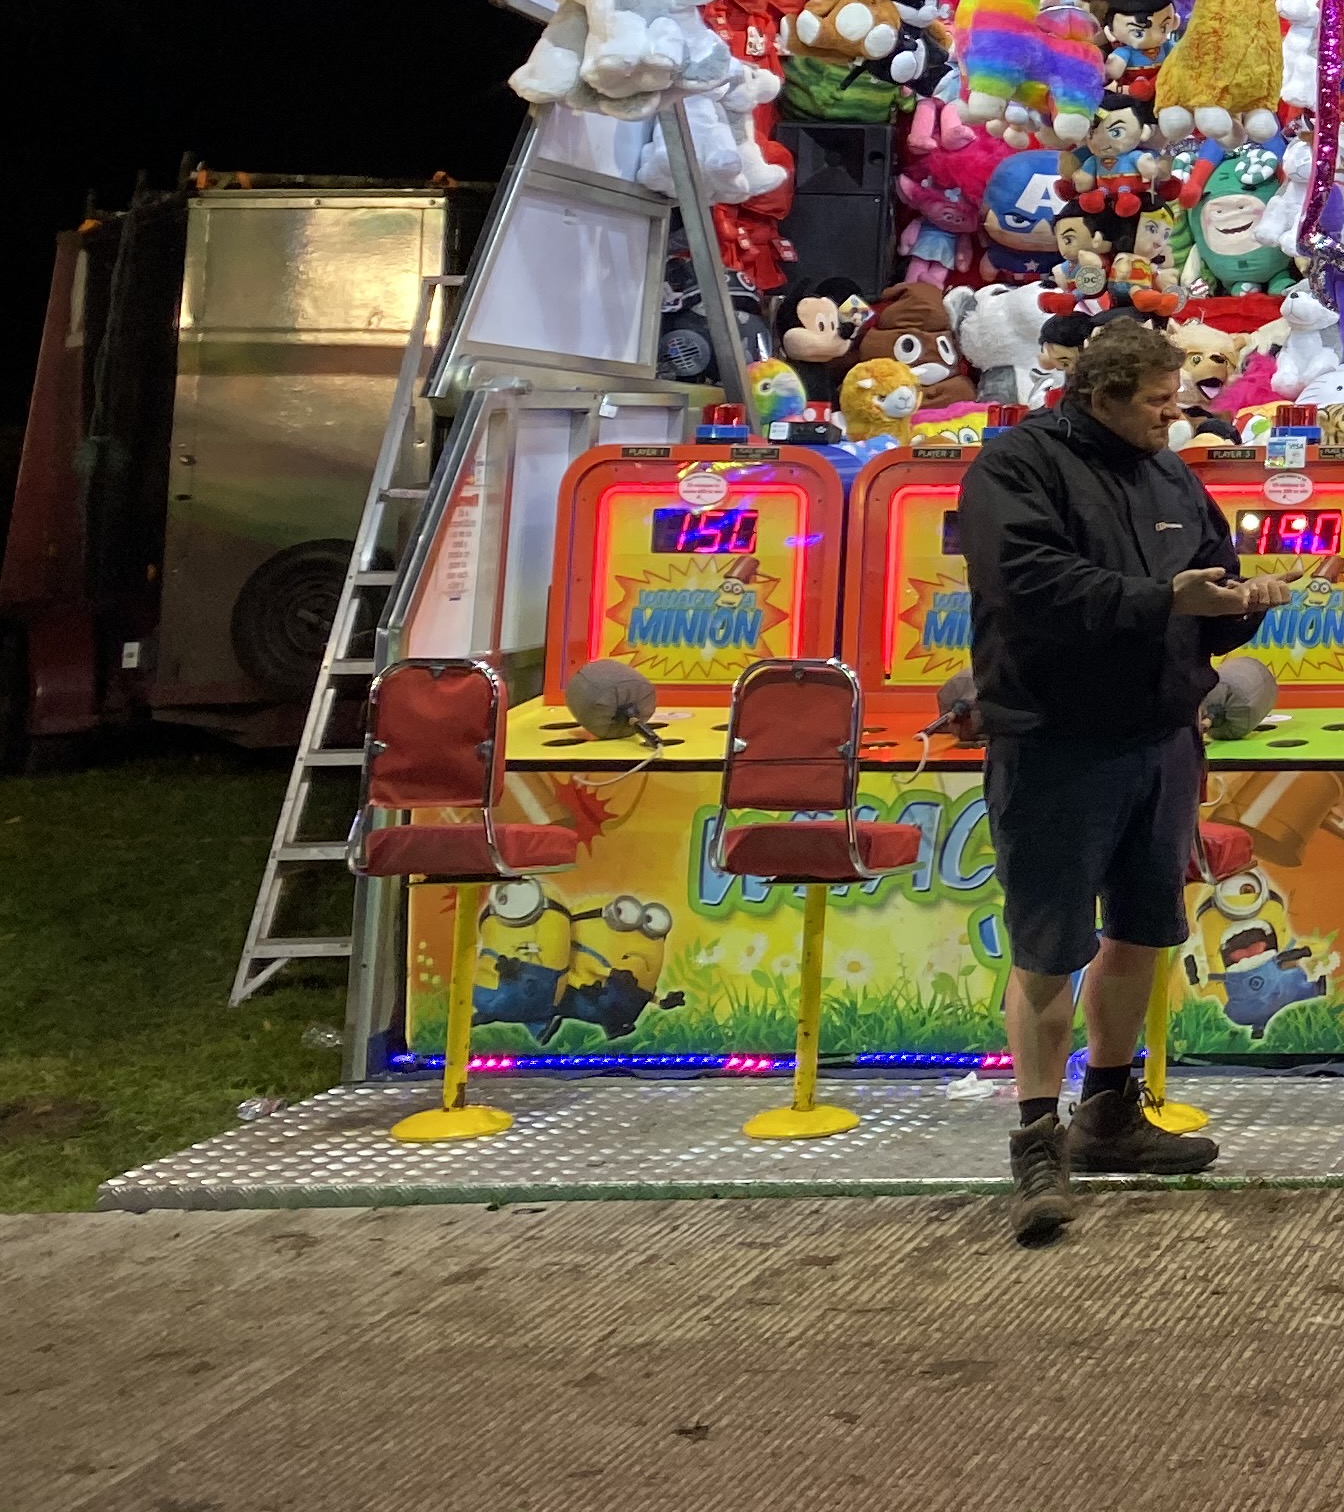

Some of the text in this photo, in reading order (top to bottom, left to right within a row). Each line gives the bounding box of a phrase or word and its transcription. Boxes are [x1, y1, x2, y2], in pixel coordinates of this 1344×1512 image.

[1083, 276, 1097, 284] DC
[1212, 450, 1242, 458] PLAYER
[676, 511, 759, 553] 150
[1258, 513, 1342, 555] 190
[742, 590, 756, 607] A
[1327, 590, 1344, 607] A
[628, 607, 763, 648] MINION
